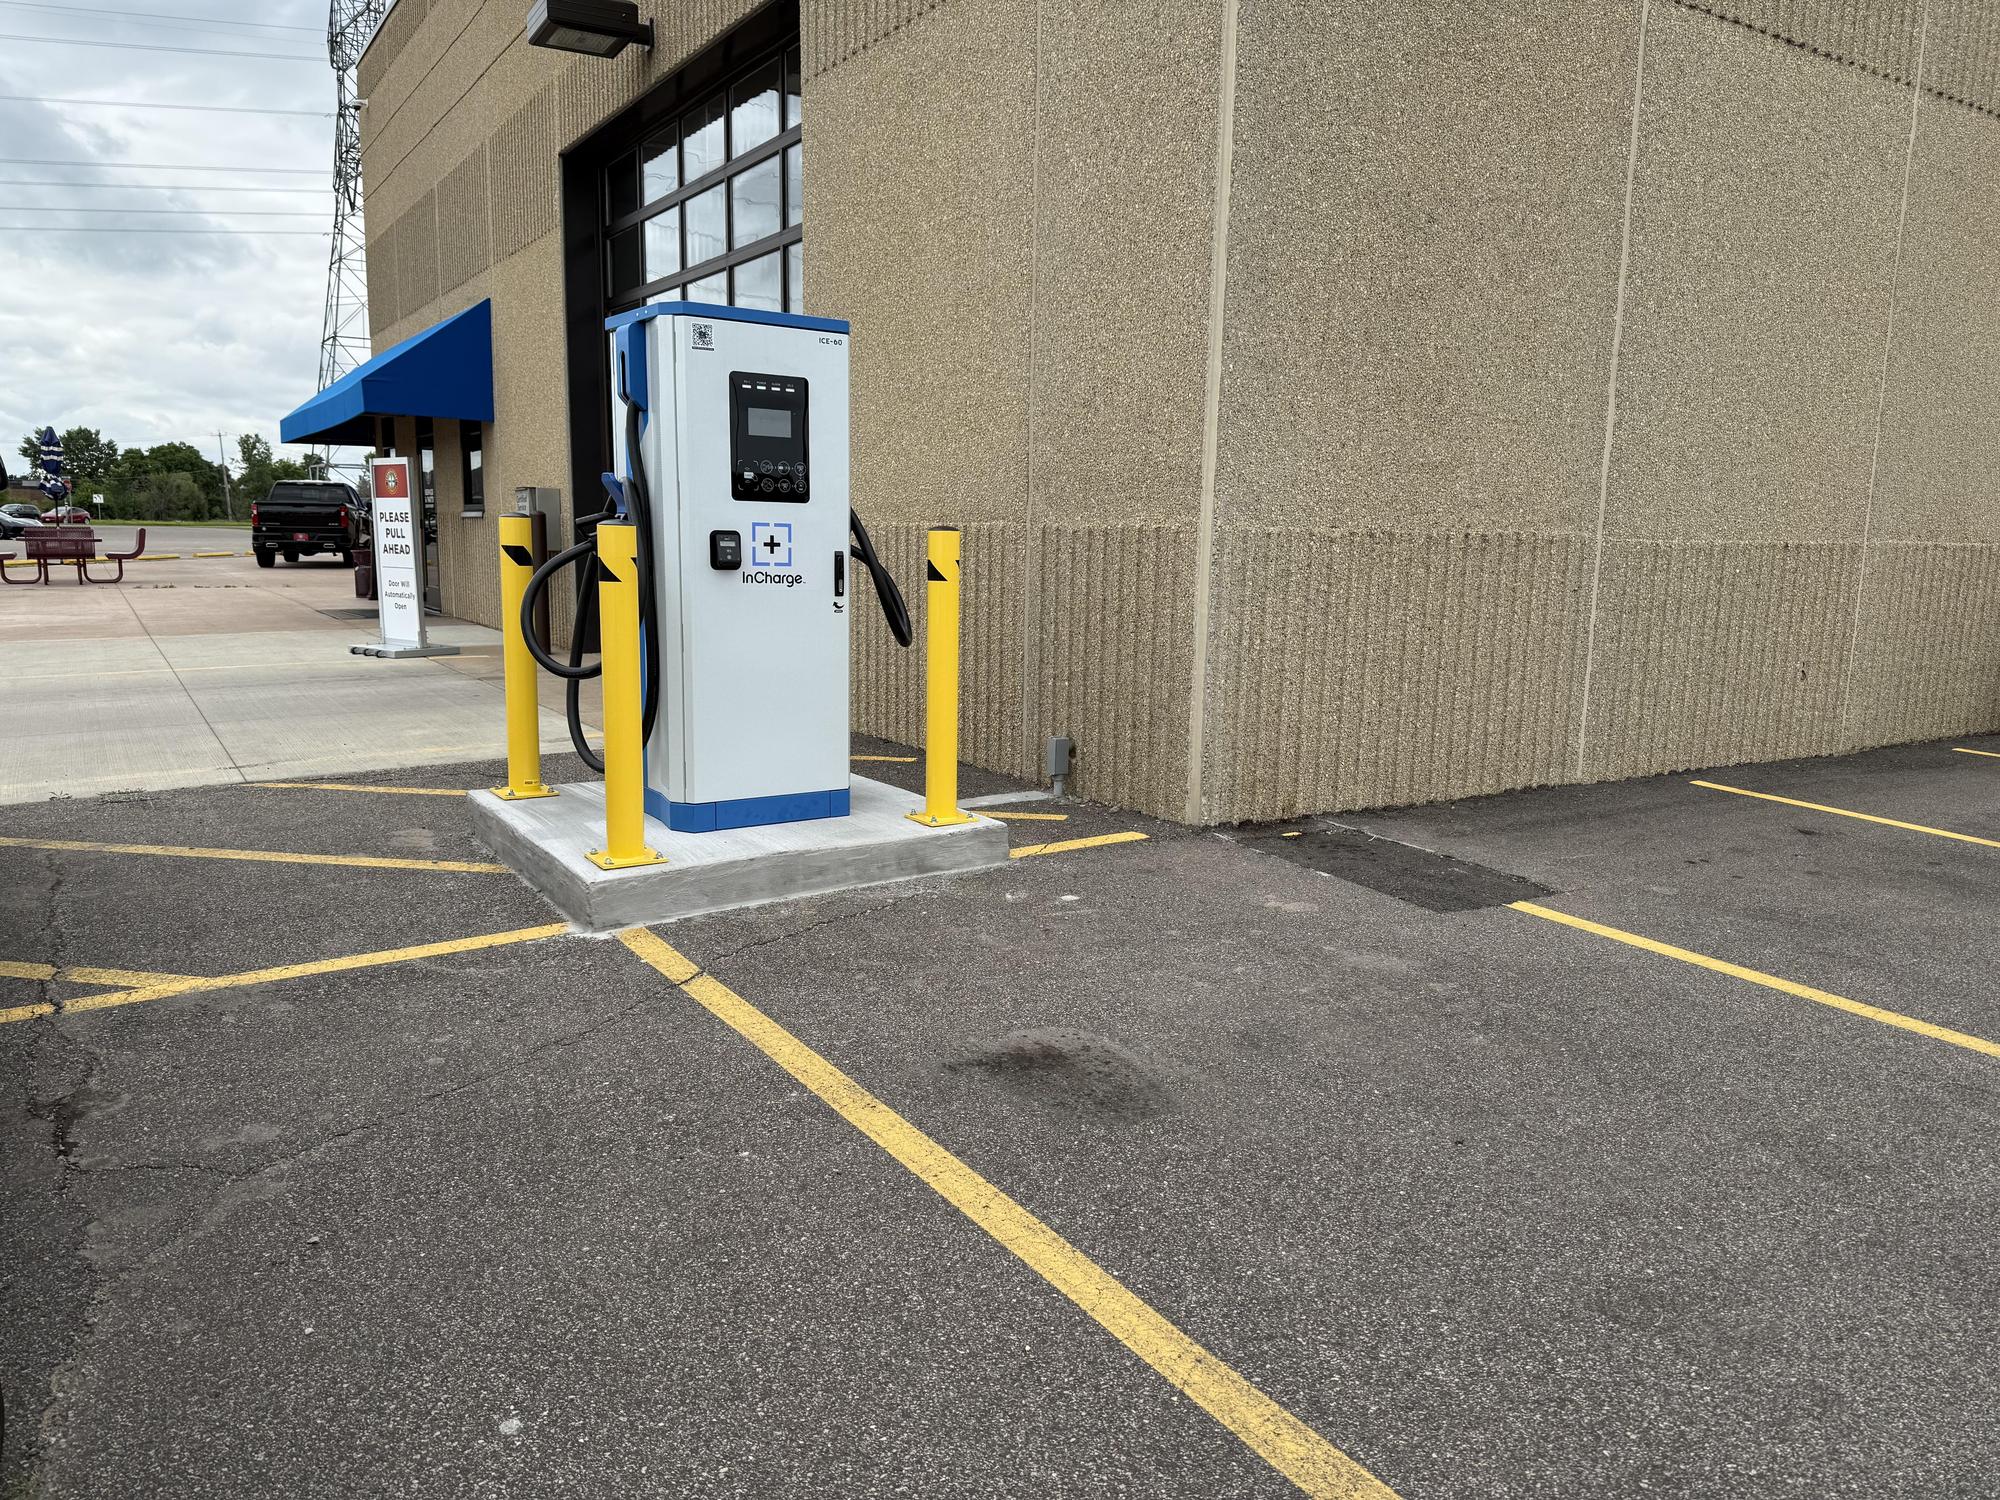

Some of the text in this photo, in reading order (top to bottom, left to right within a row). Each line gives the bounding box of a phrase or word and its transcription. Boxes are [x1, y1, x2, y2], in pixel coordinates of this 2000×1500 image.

[818, 337, 843, 346] ICE-60
[379, 511, 410, 523] PLEASE
[385, 527, 406, 539] PULL
[382, 543, 411, 555] AHEAD
[388, 579, 400, 587] Door
[394, 602, 408, 611] Open
